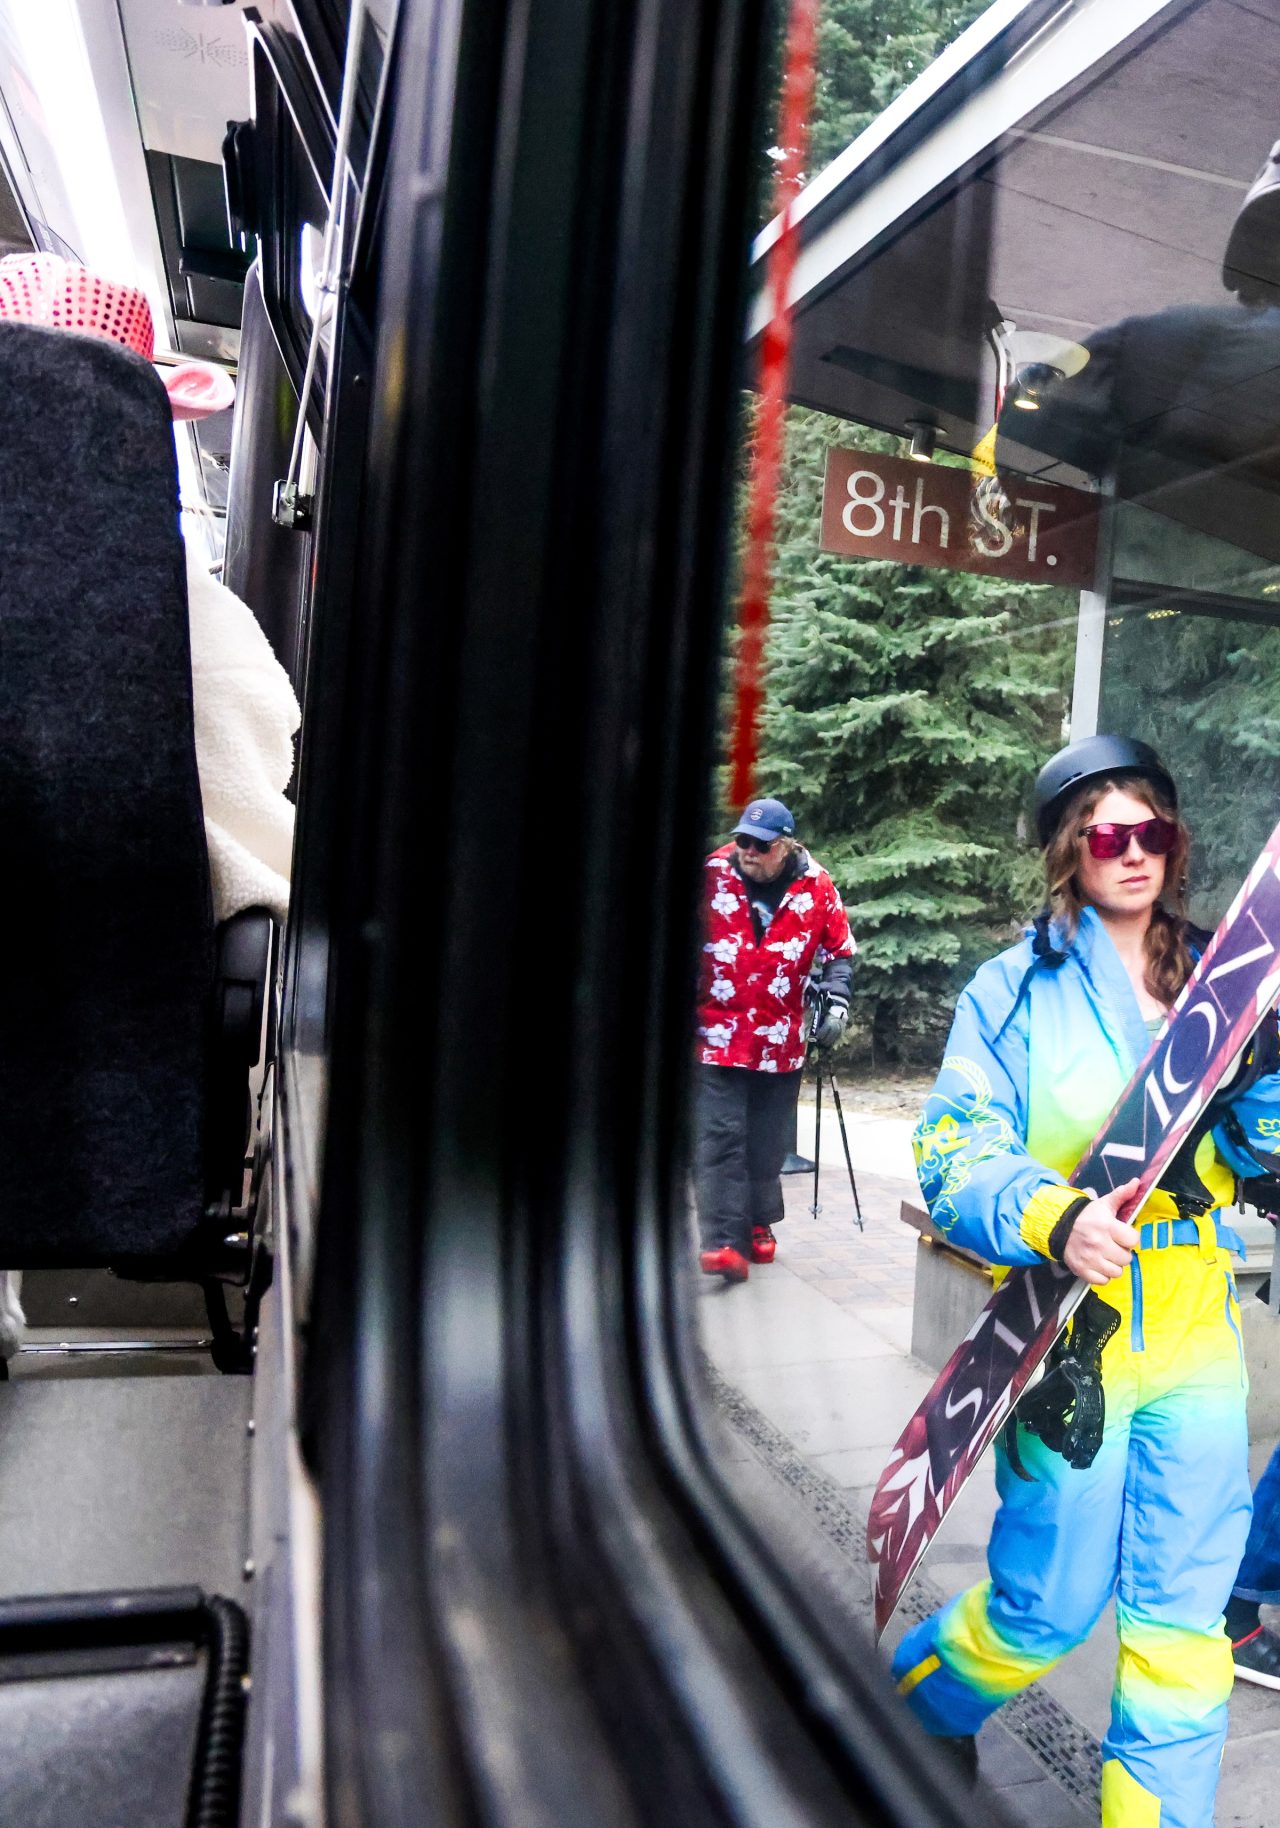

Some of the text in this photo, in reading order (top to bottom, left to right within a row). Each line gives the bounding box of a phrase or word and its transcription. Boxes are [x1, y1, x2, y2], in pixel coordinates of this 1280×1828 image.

[841, 470, 1058, 567] 8th ST.
[943, 911, 1276, 1459] SALMON
